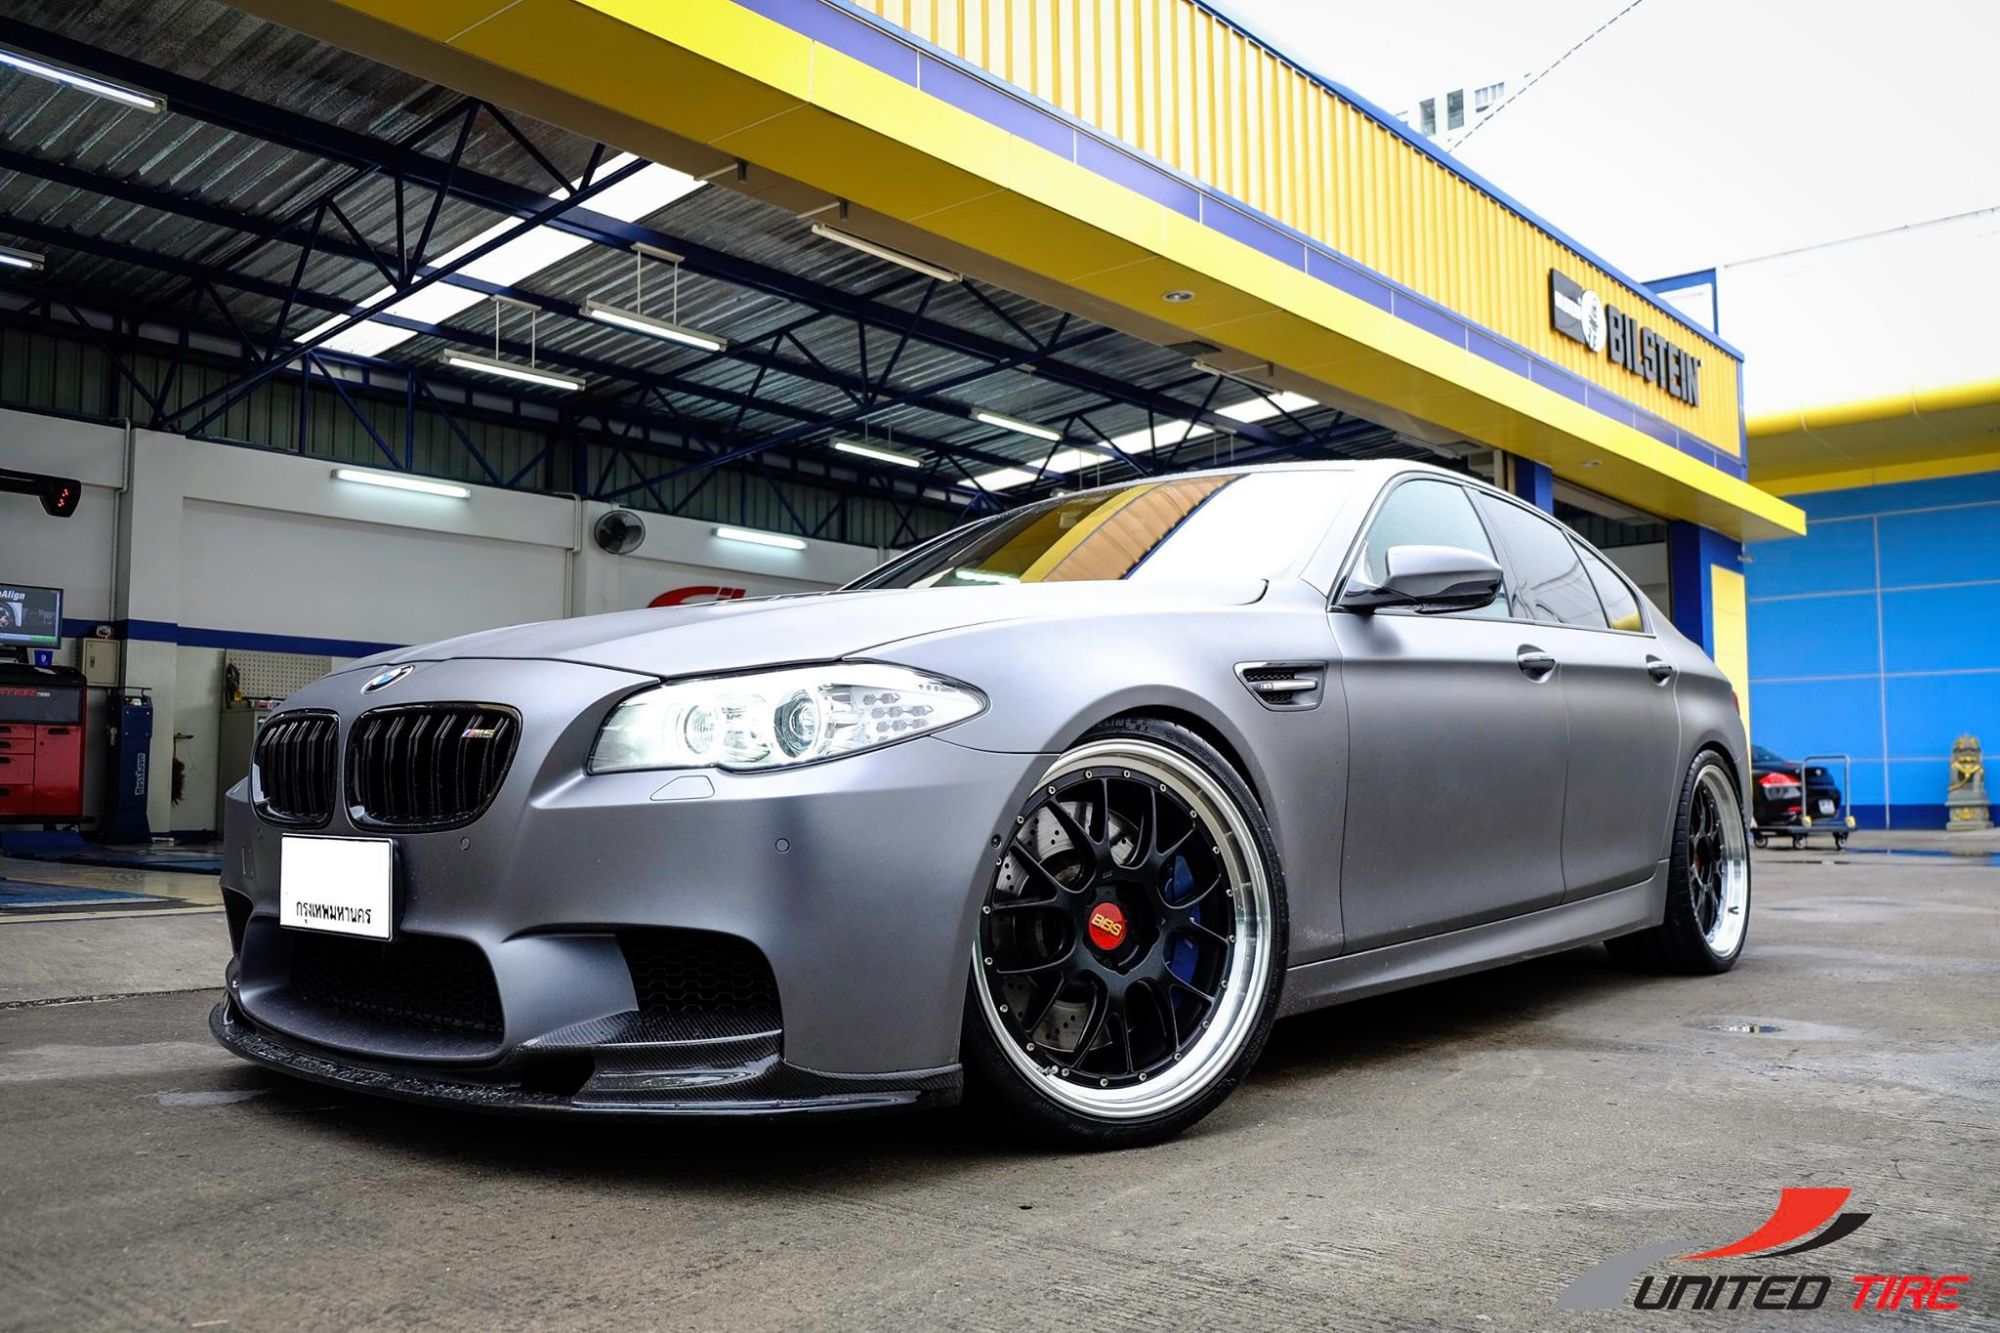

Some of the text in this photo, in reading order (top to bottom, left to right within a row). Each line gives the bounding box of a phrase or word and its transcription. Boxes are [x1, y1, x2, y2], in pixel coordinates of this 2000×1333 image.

[1606, 303, 1699, 407] BILSTEIN
[296, 901, 372, 925] กรุงเทพมหานคร
[1091, 913, 1123, 936] BBS
